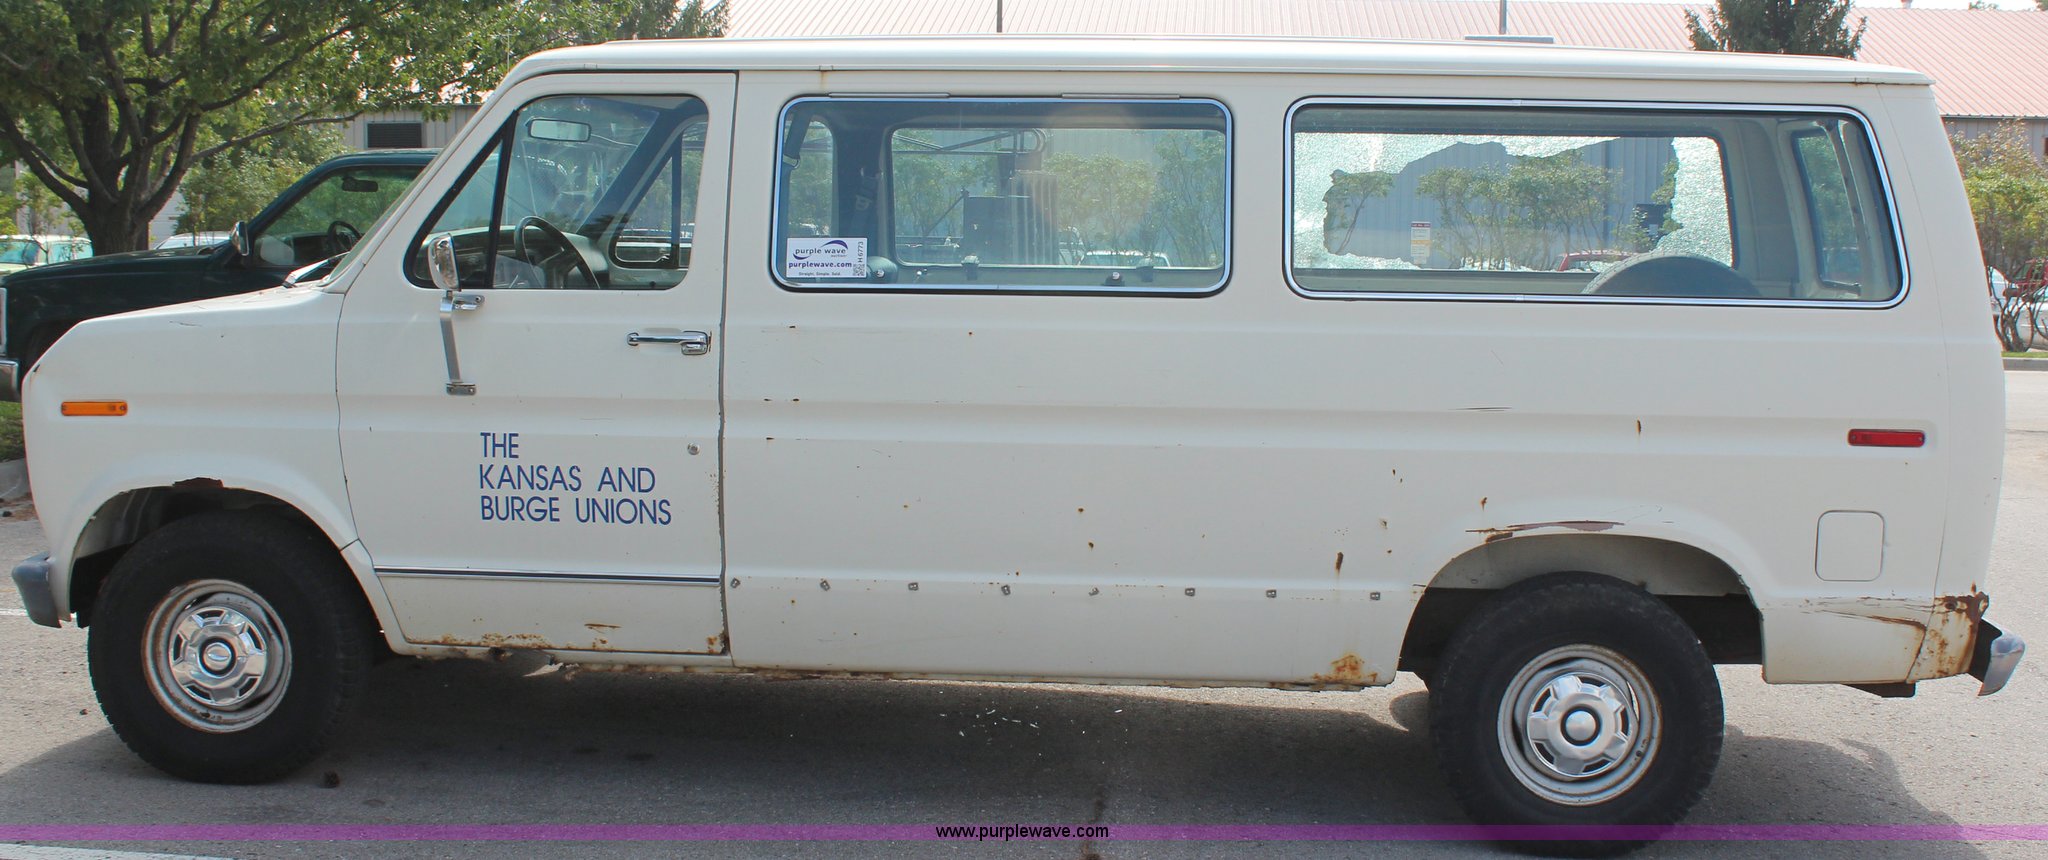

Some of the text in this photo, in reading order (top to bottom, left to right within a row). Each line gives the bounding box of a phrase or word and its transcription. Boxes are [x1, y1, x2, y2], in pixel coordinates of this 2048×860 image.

[788, 261, 852, 269] purplewave.com
[480, 432, 519, 459] THE
[479, 464, 656, 493] KANSAS AND
[480, 495, 672, 525] BURGE UNIONS
